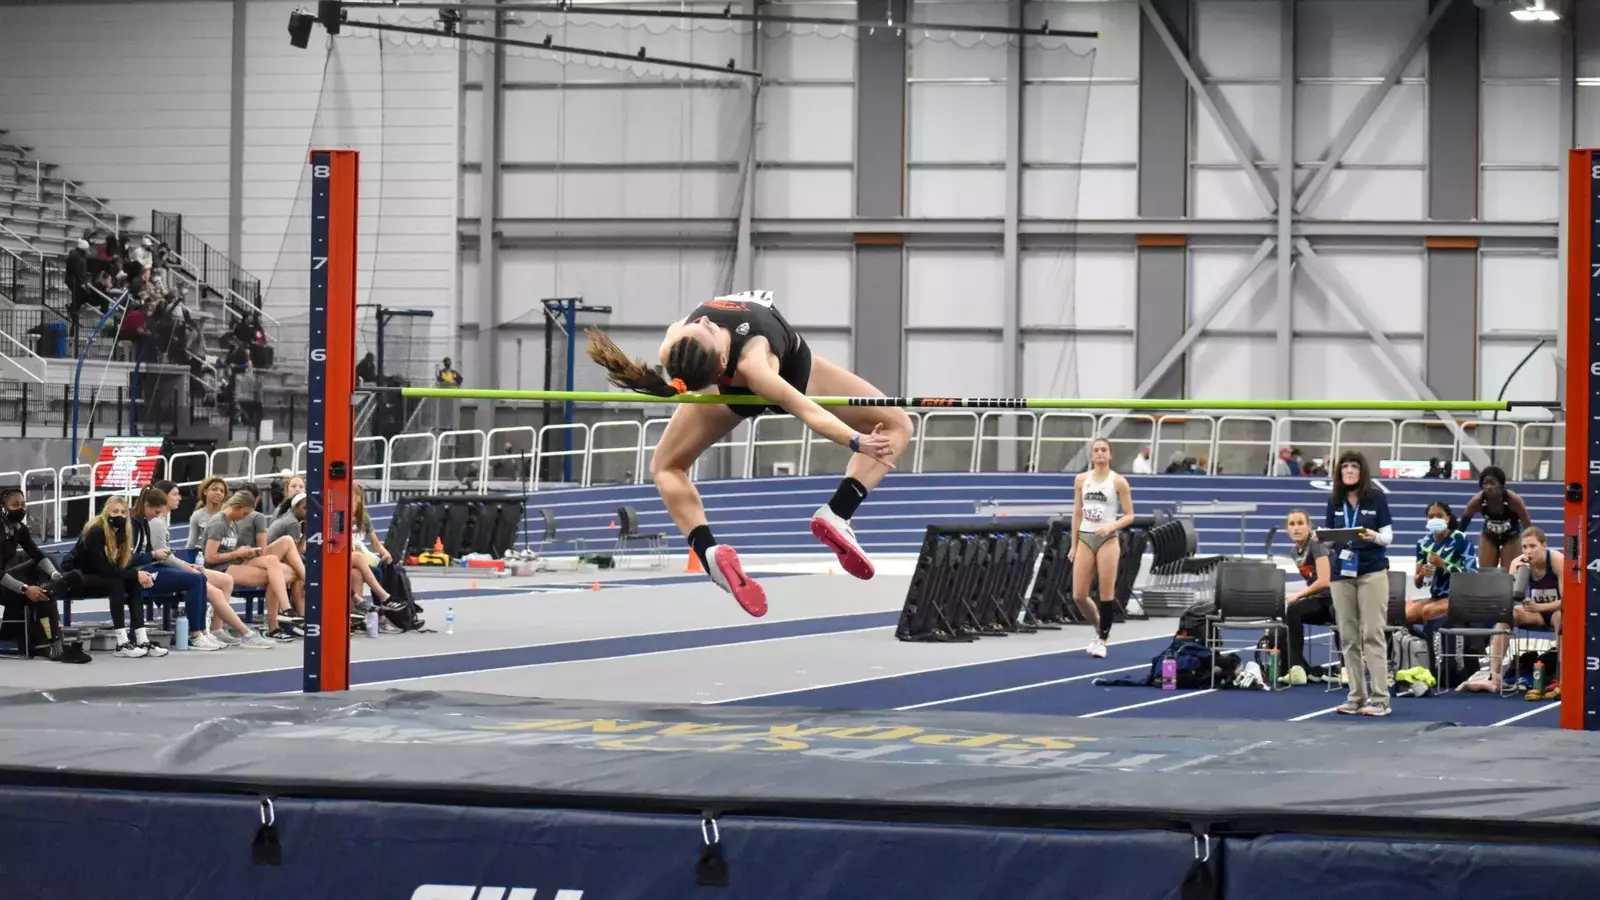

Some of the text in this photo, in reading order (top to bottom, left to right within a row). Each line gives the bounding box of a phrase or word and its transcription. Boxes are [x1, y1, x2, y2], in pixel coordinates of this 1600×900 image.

[314, 165, 330, 178] 8
[312, 257, 328, 269] 7
[310, 349, 326, 361] 6
[308, 441, 324, 453] 5
[307, 532, 324, 545] 4
[1587, 558, 1600, 572] 4
[306, 624, 321, 636] 3
[1586, 657, 1600, 670] 3
